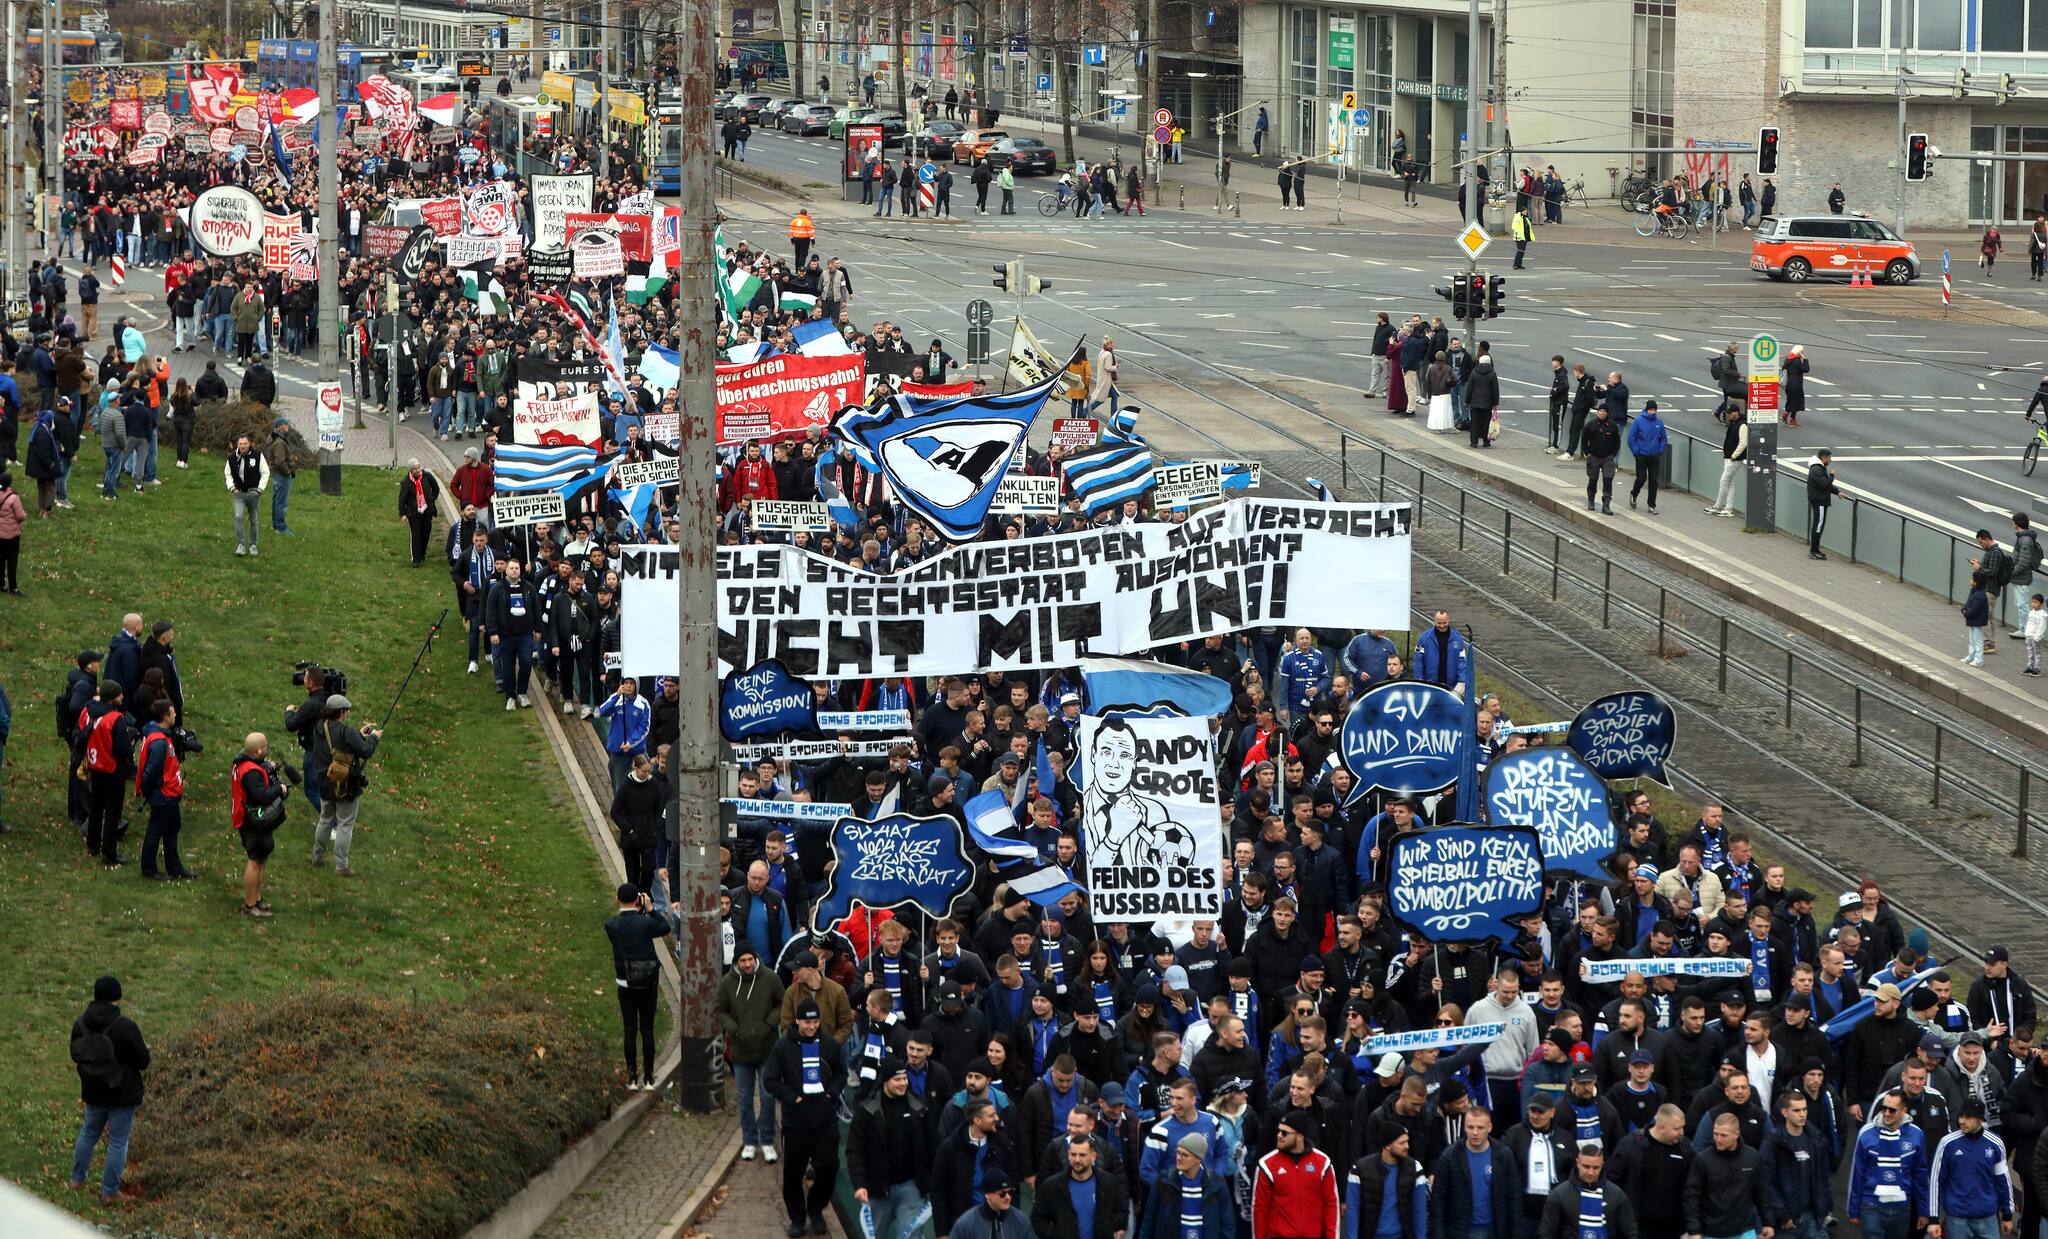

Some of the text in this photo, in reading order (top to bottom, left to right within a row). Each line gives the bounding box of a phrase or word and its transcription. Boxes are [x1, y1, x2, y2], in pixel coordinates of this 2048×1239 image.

[816, 22, 823, 31] E
[1088, 49, 1097, 62] T
[1040, 76, 1048, 88] P
[1397, 80, 1415, 93] JOHN
[1415, 83, 1432, 95] REED
[1345, 94, 1354, 108] 2
[537, 180, 557, 192] IMMER
[537, 194, 586, 208] GEGEN DEN
[202, 219, 252, 240] STOPPEN
[560, 366, 590, 376] EURE
[716, 365, 861, 406] Überwachungswahn!
[527, 399, 575, 415] FREIHEIT
[529, 412, 559, 424] UNSERE
[1063, 419, 1090, 427] FAKTEN
[1054, 432, 1096, 440] POPULISMUS
[622, 460, 678, 475] DIE STADIE
[1154, 464, 1219, 486] GEGEN
[624, 473, 647, 485] SIND
[1001, 479, 1056, 492] NKULTUR
[1156, 486, 1220, 500] EINTRITTSKARTEN
[495, 496, 561, 508] SICHERHEITSWAHN
[497, 502, 563, 519] STOPPEN!
[756, 502, 826, 515] FUSSBALL
[757, 514, 828, 525] NUR MIT UNS!
[621, 550, 781, 579] MITELS
[1167, 509, 1226, 551] AUF
[1245, 504, 1411, 538] VERDACHT
[727, 585, 801, 615] DEN
[826, 571, 1087, 617] RECHTSSTAAT
[718, 563, 1289, 675] NICHT MIT UNS!
[734, 669, 778, 690] KEINE
[728, 691, 812, 720] KOMMISSION!
[1383, 691, 1432, 721] SV
[1597, 695, 1646, 716] DIE
[856, 713, 906, 725] STOPPEN!
[1582, 711, 1663, 736] STADIEN
[1135, 734, 1209, 765] ANDY
[1348, 727, 1463, 756] UND DANN
[734, 744, 783, 760] ULISMUS
[1130, 766, 1216, 803] GROTE
[1492, 785, 1602, 818] STUFEN-
[843, 823, 921, 841] SV HAT
[1539, 820, 1615, 859] INDERN!
[857, 839, 941, 856] NOCH NIE
[859, 852, 931, 869] ETWAS
[851, 863, 967, 887] GEBRACHT!
[1092, 866, 1216, 889] FEIND DES
[1397, 856, 1542, 887] SPIELBALL EURER
[1393, 876, 1543, 913] SYMBOLPOLITIK
[1093, 893, 1220, 916] FUSSBALLS
[1590, 959, 1675, 977] POPULISMUS
[1366, 1028, 1440, 1051] OPULISMUS
